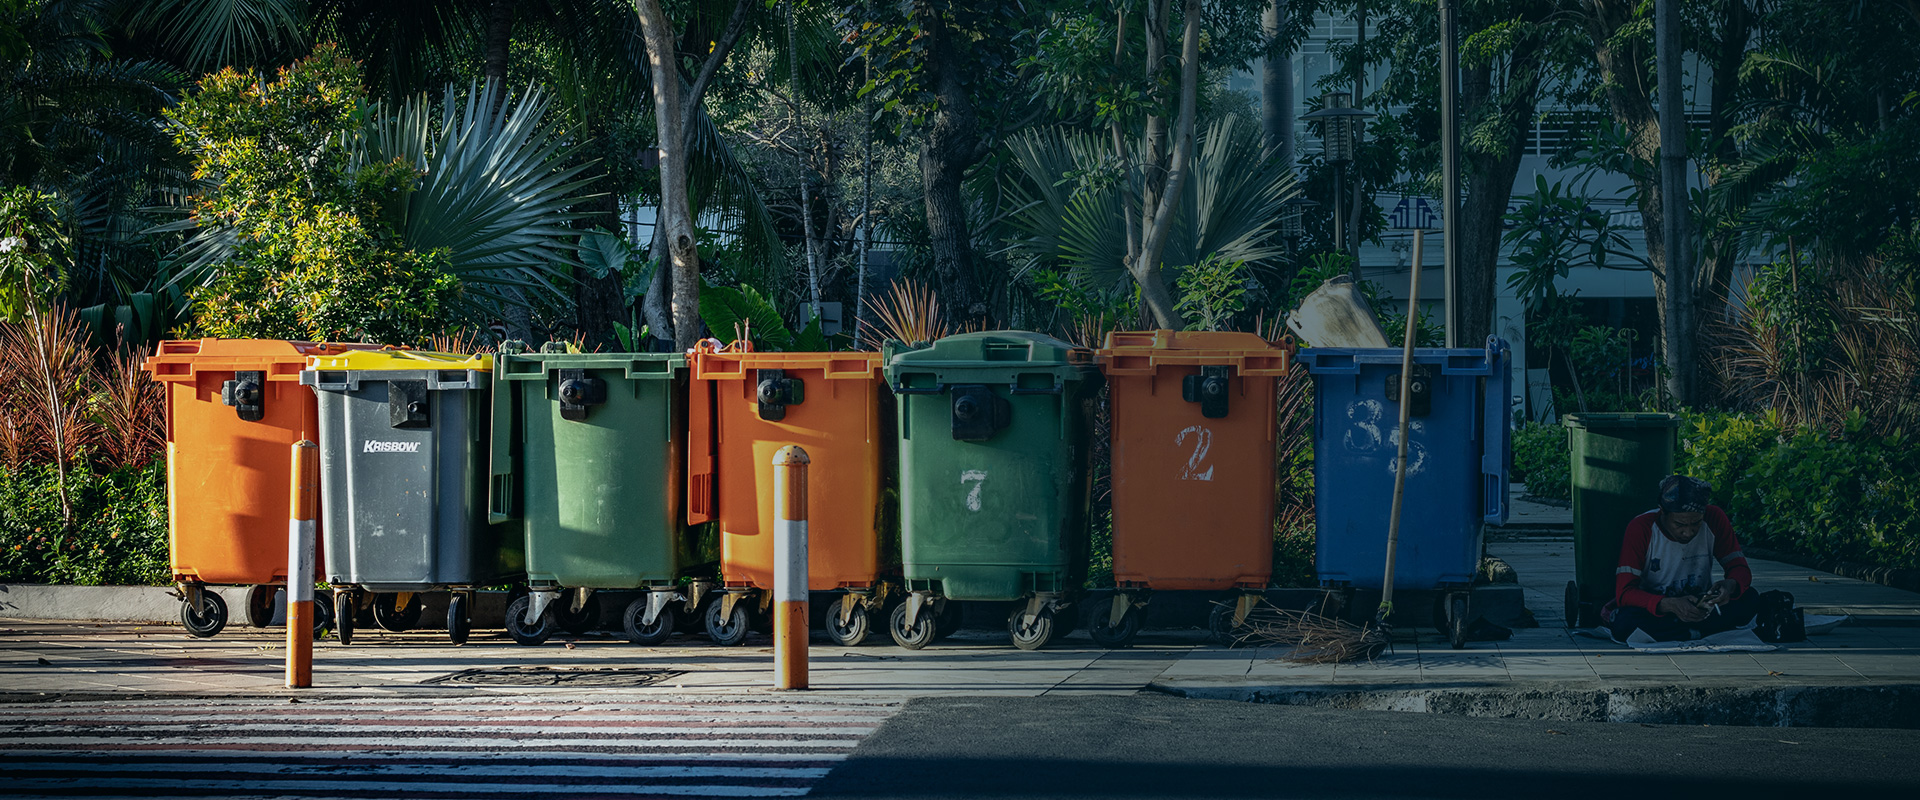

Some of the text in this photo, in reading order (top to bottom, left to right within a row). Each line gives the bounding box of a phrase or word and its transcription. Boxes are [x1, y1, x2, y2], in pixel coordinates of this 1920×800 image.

[363, 440, 421, 453] KRISBOW
[1174, 425, 1214, 481] 2
[961, 469, 988, 511] 7
